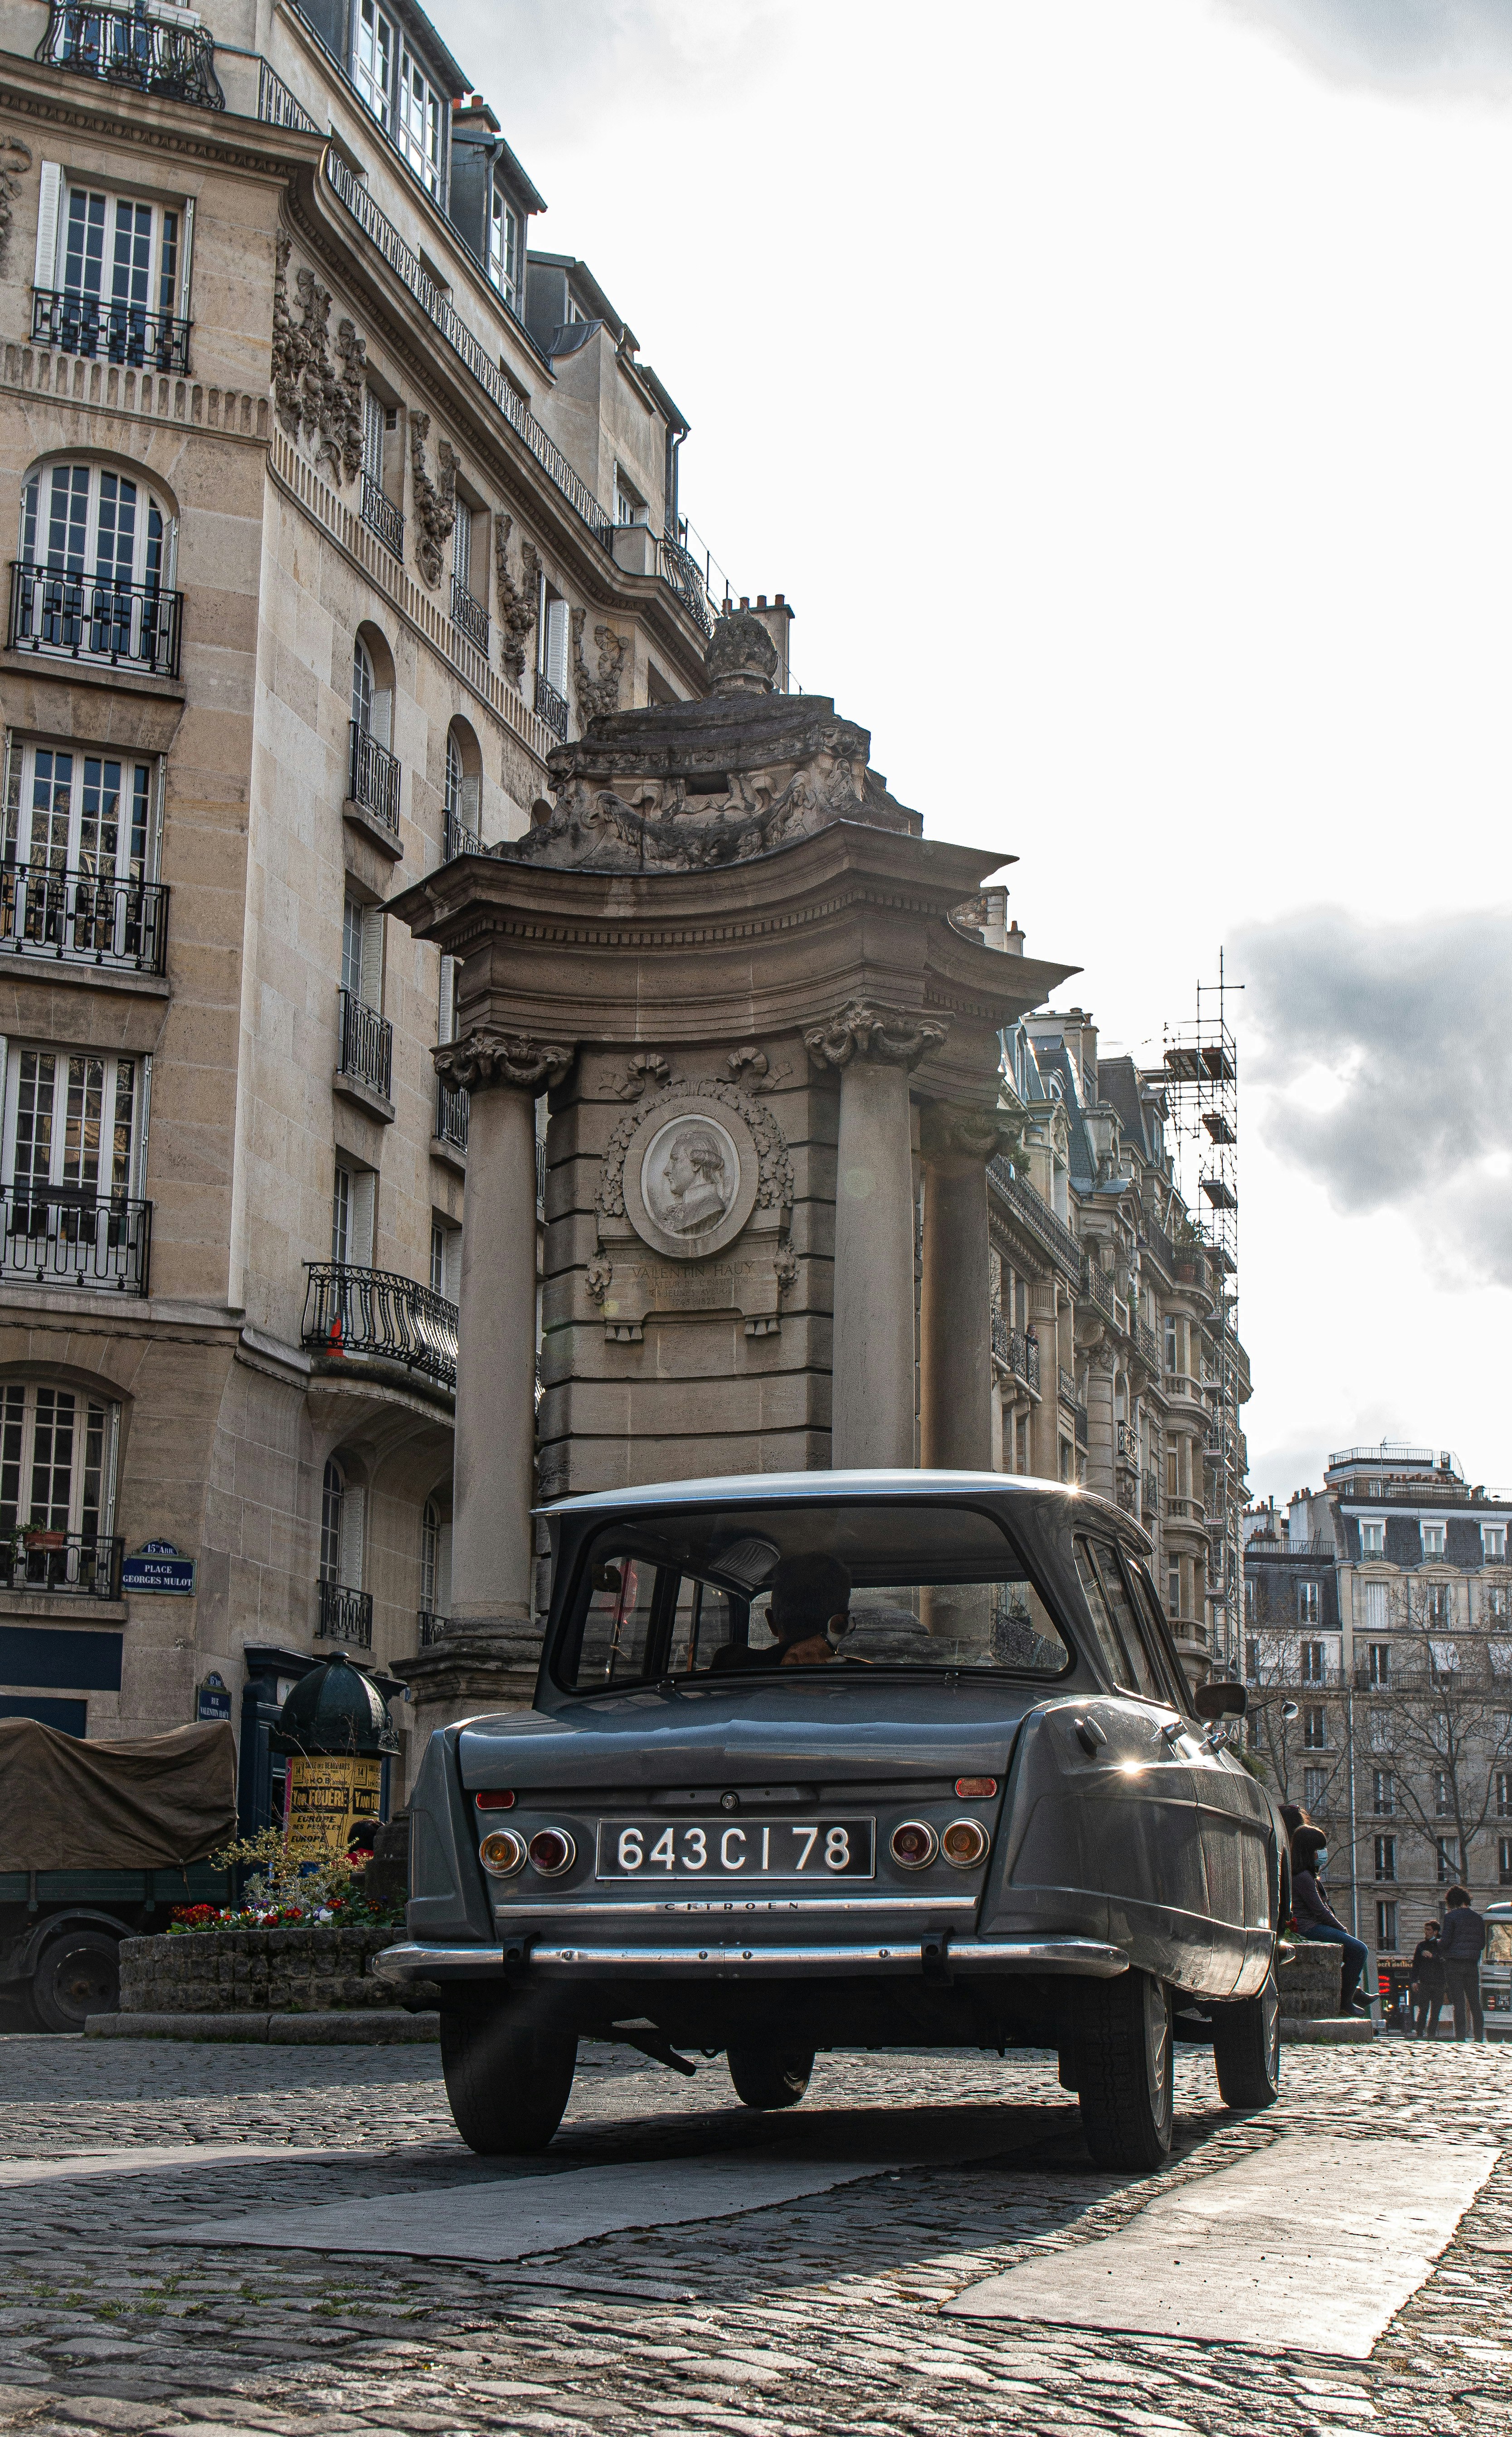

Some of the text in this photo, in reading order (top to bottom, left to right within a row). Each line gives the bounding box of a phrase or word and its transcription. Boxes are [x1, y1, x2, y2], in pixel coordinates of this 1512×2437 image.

[632, 1265, 705, 1279] VALENTIN
[145, 1565, 172, 1574] PLACE
[123, 1574, 192, 1586] GEORGES MULOT
[200, 1706, 219, 1717] VALENTIN
[617, 1828, 708, 1871] 643
[792, 1827, 850, 1871] 78
